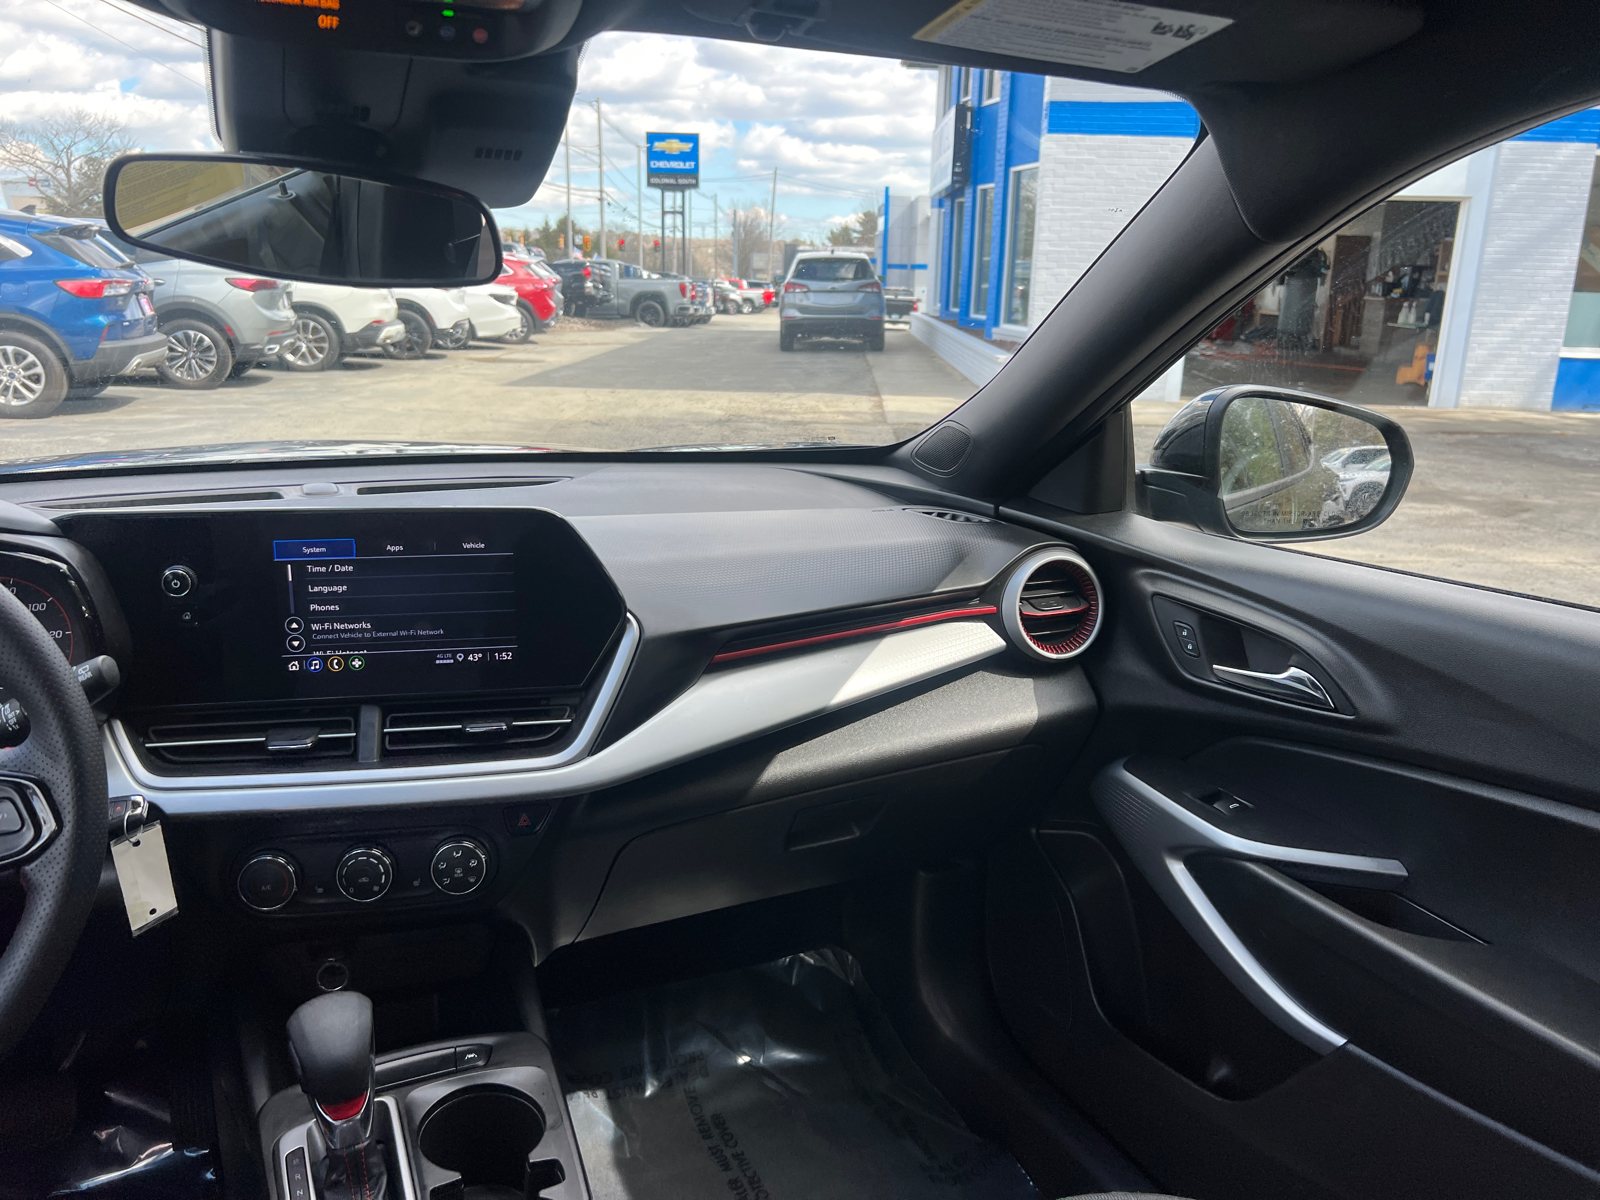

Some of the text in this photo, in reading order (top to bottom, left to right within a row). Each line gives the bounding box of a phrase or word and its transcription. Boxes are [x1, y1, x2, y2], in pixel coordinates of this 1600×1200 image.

[317, 14, 339, 29] OFF
[650, 160, 696, 169] CHEVROLET
[302, 546, 327, 554] System
[386, 544, 404, 552] Apps
[334, 564, 354, 572] Date
[308, 584, 348, 594] Language
[28, 602, 47, 612] 100
[310, 604, 340, 612] Phones
[311, 621, 372, 630] Wi-Fi Networks
[372, 630, 398, 638] External
[400, 629, 417, 637] Wi-Fi
[417, 628, 444, 636] Network
[494, 651, 512, 660] 1:52
[682, 1085, 714, 1140] REMOVE
[710, 1111, 739, 1148] COVER
[707, 1144, 734, 1172] MUST
[294, 1173, 302, 1181] R
[296, 1188, 303, 1197] N
